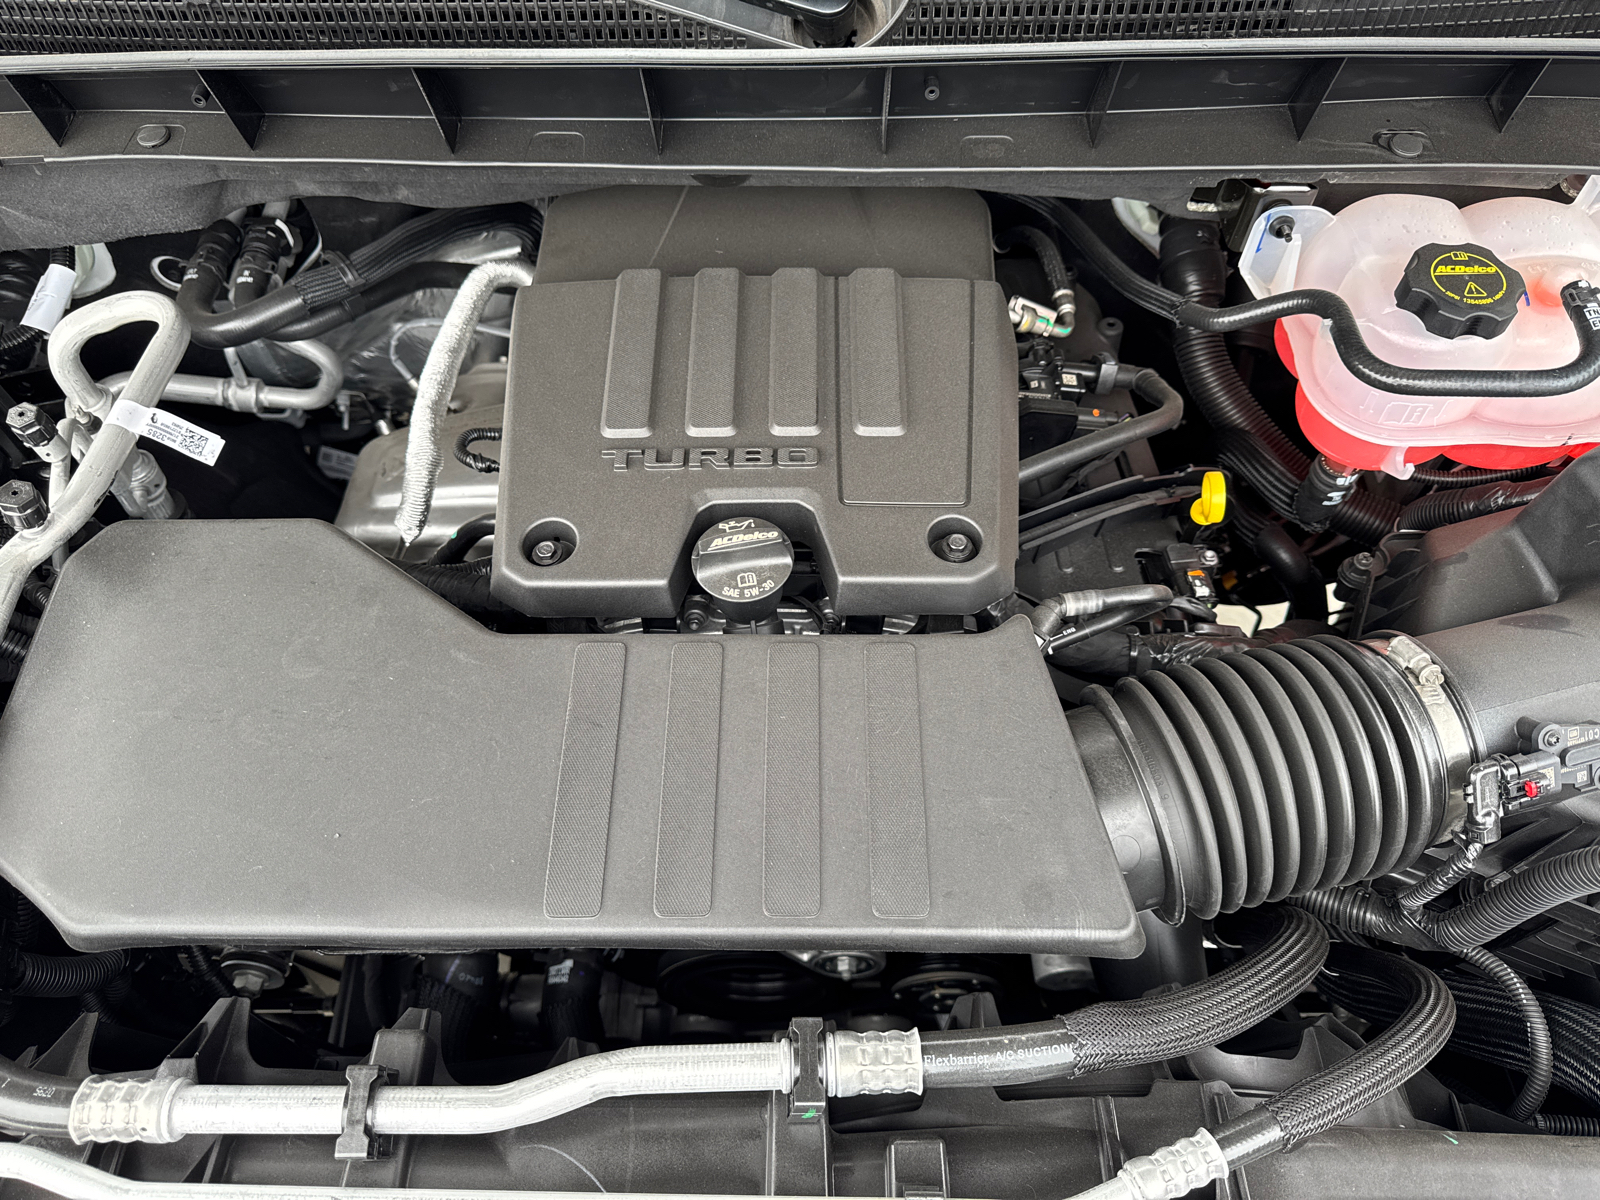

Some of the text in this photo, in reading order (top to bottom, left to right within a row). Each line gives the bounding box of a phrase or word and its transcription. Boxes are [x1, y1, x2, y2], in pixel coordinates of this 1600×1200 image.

[1435, 264, 1497, 273] ACDelco
[601, 448, 818, 471] TURBO
[709, 531, 779, 548] ACDelco
[722, 579, 775, 598] SAE 5W-30
[923, 1052, 989, 1067] Flexbarrier
[995, 1051, 1015, 1062] A/C
